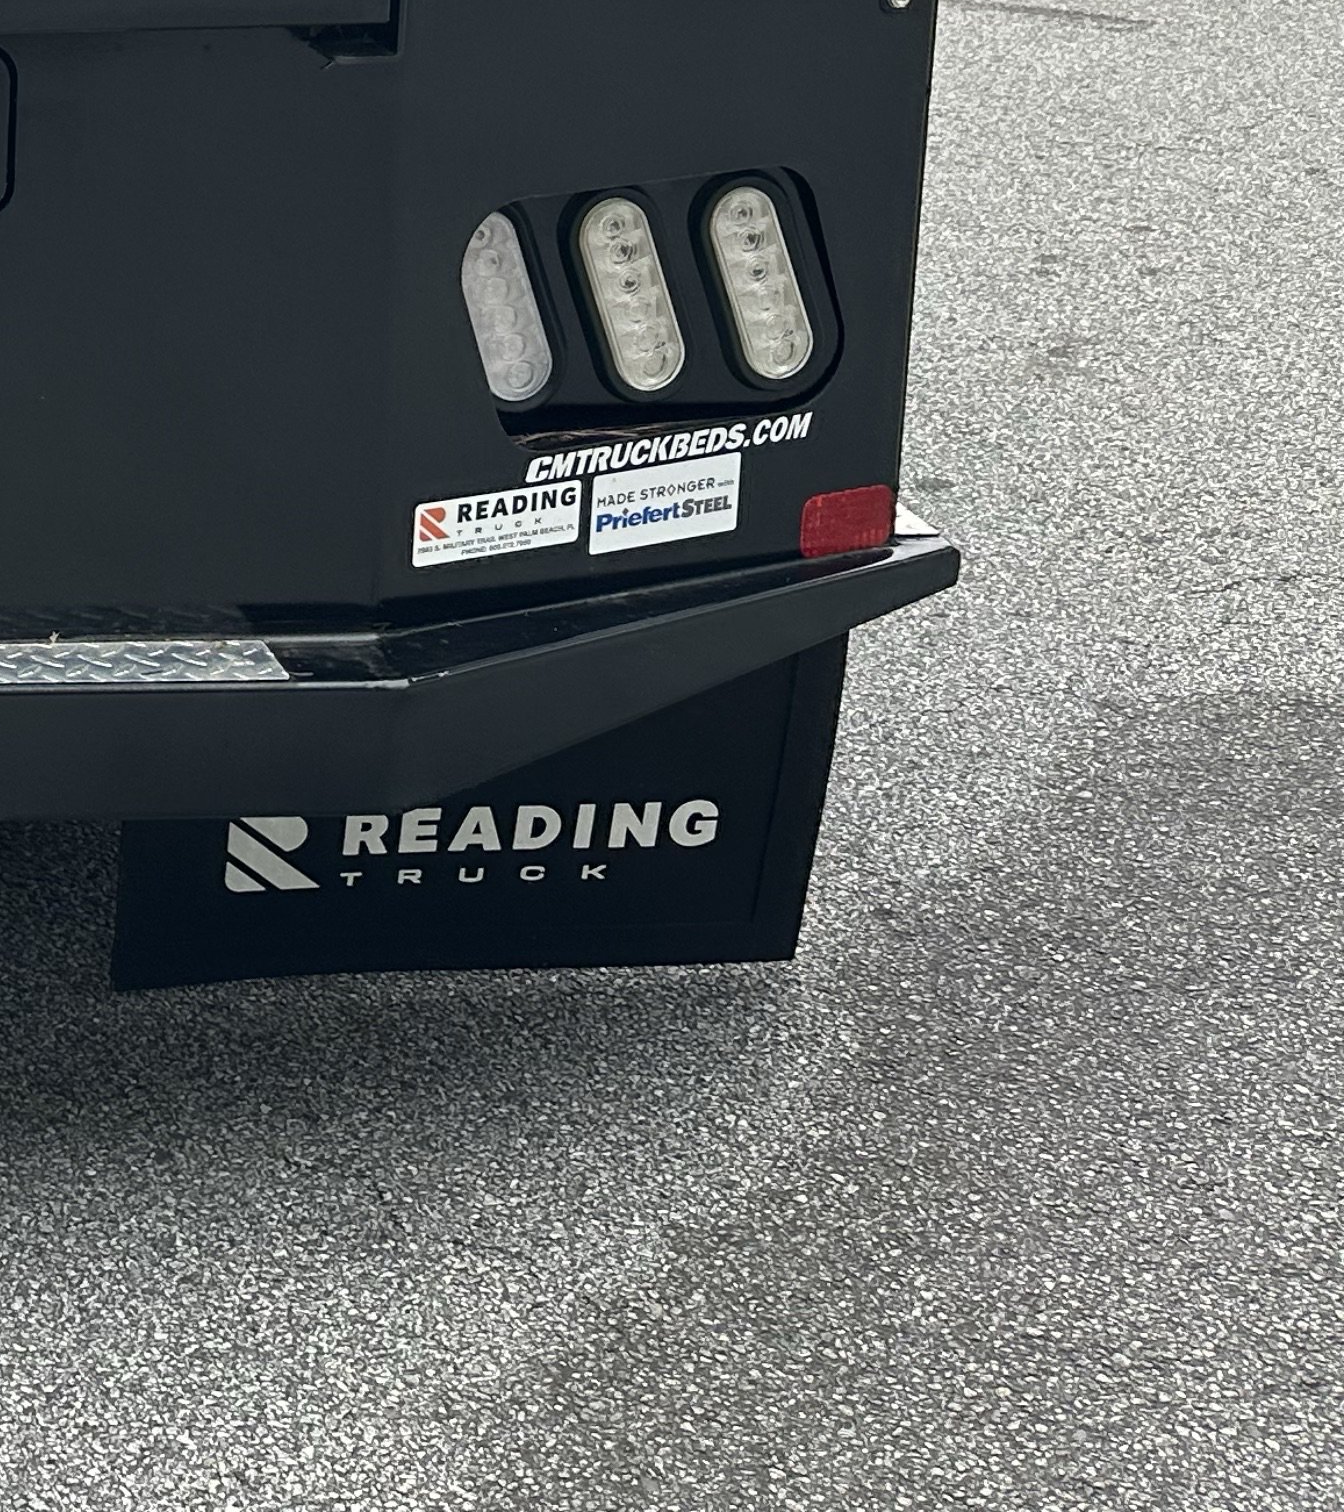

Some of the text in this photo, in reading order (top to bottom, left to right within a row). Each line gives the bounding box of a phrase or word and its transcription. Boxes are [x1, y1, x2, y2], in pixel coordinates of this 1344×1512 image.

[525, 412, 813, 483] CMTRUCKBEDS.COM
[456, 487, 577, 524] READING
[596, 491, 636, 508] MADE
[640, 477, 716, 501] STRONGER
[456, 517, 543, 536] TRUCK
[341, 799, 720, 856] READING
[339, 864, 608, 887] TRUCK
